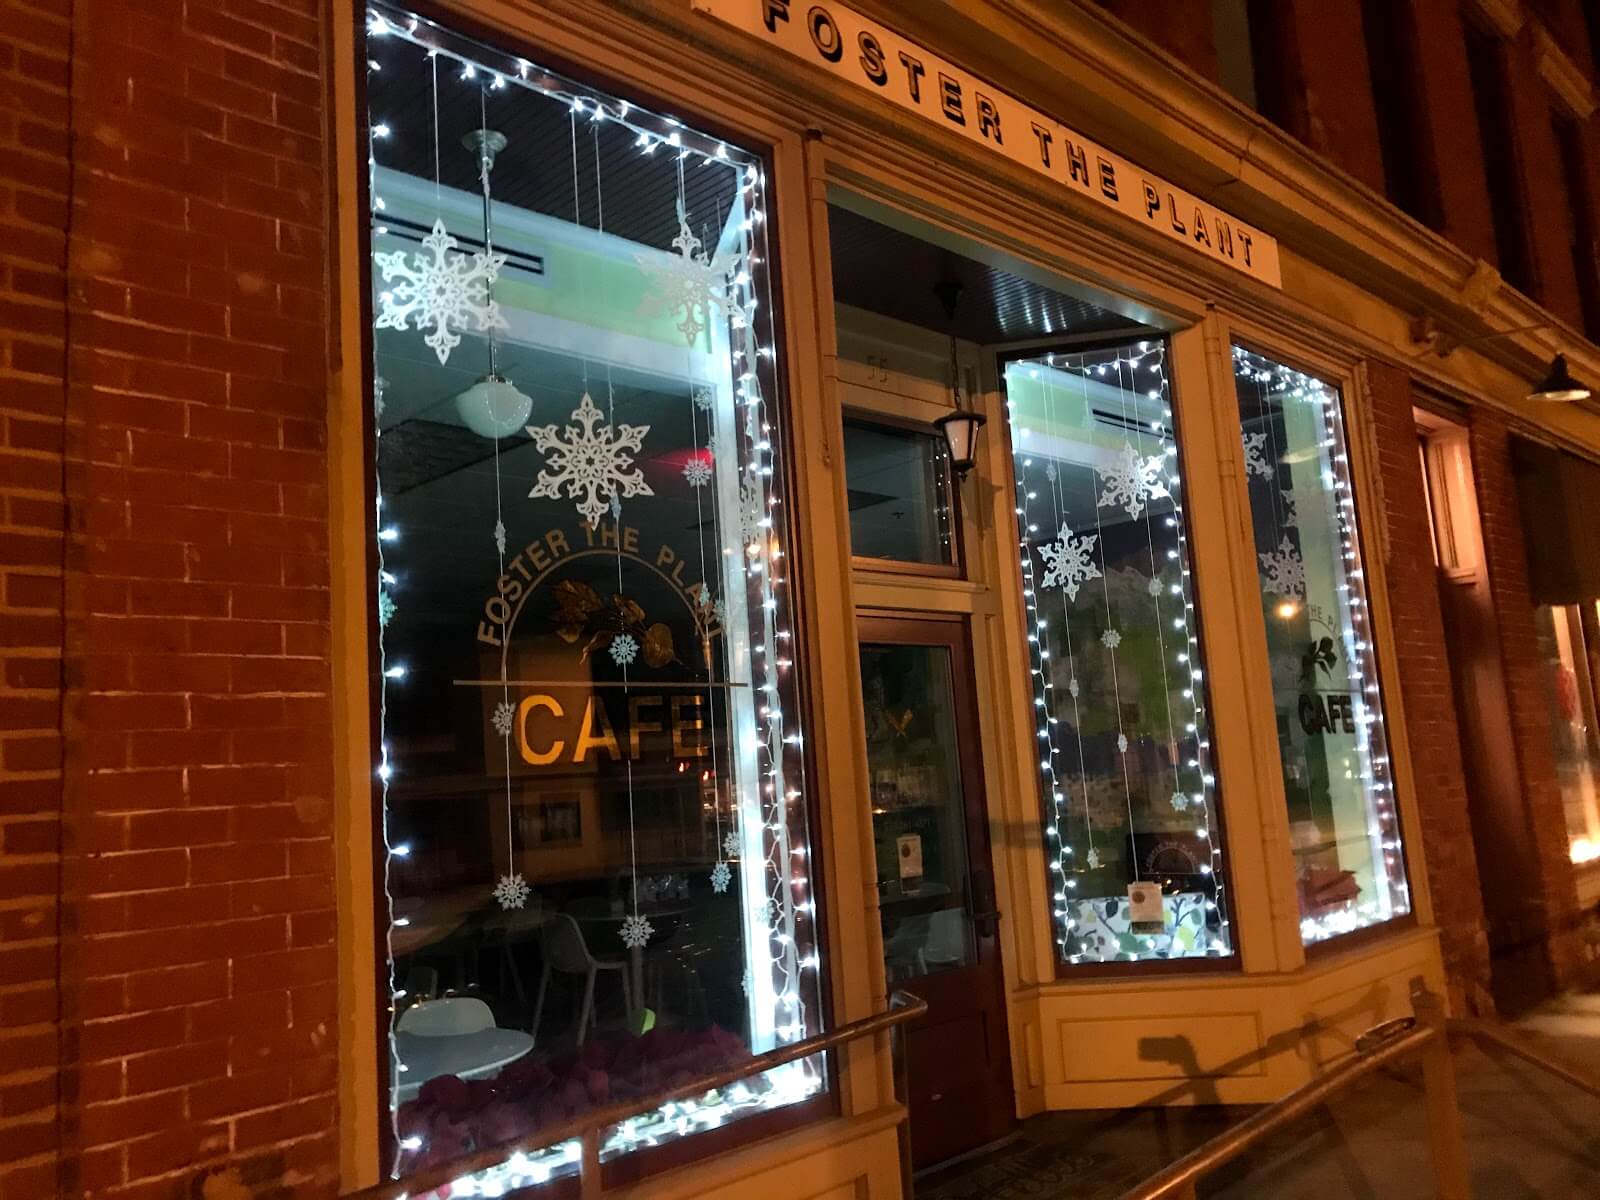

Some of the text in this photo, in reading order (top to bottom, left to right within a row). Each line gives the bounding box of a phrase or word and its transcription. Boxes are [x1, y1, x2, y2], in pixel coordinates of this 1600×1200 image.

[761, 0, 1253, 268] FOSTER THE PLANT
[477, 528, 571, 648] FOSTER
[579, 521, 640, 552] THE
[519, 694, 709, 766] CAFE
[1298, 693, 1356, 736] CAFE
